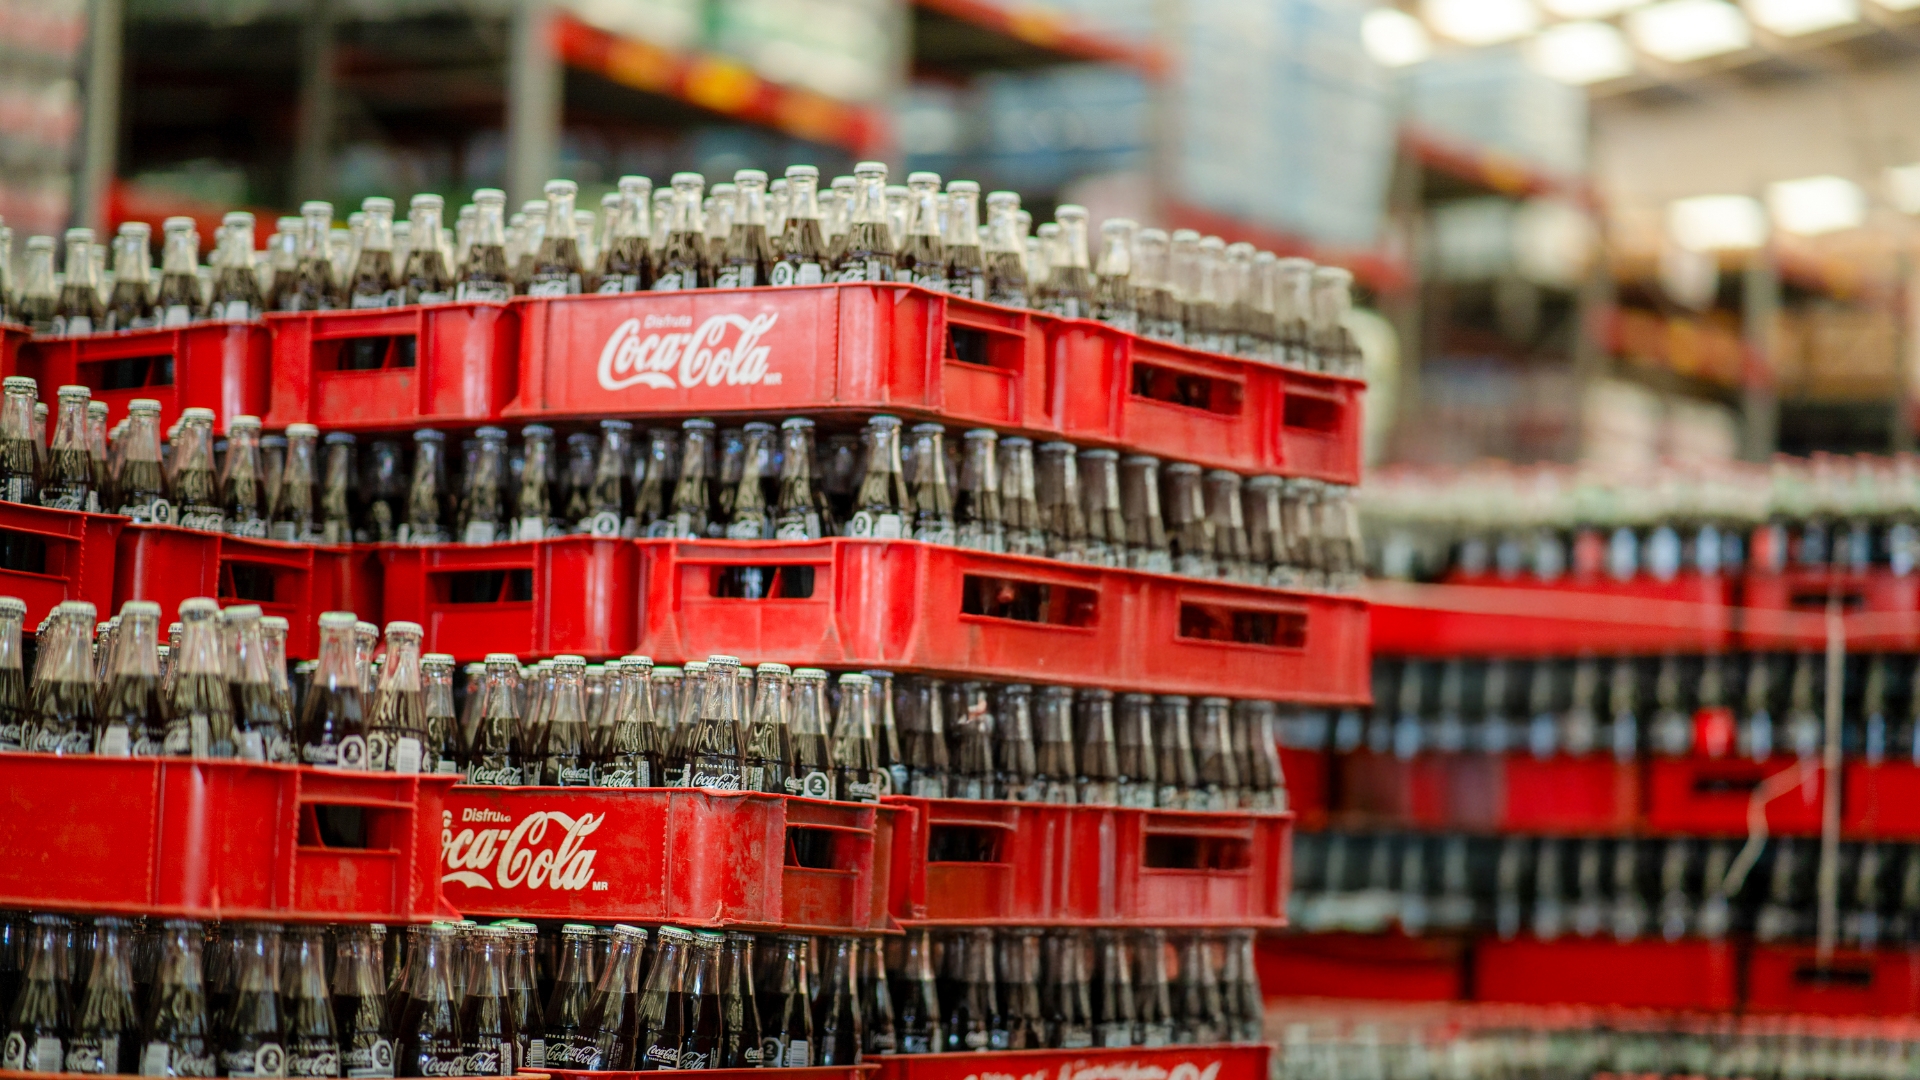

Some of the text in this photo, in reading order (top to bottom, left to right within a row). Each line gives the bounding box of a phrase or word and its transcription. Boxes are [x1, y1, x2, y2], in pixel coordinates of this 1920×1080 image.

[644, 314, 692, 329] Disfruta
[597, 312, 779, 391] Coca-Cola
[473, 766, 523, 785] Coca-Cola
[691, 771, 741, 790] Coca-Cola
[813, 779, 823, 789] 2
[441, 810, 608, 891] oca-Cola MR
[381, 1048, 388, 1060] 2
[647, 1045, 679, 1060] Coca-Cola
[765, 1045, 774, 1054] 2
